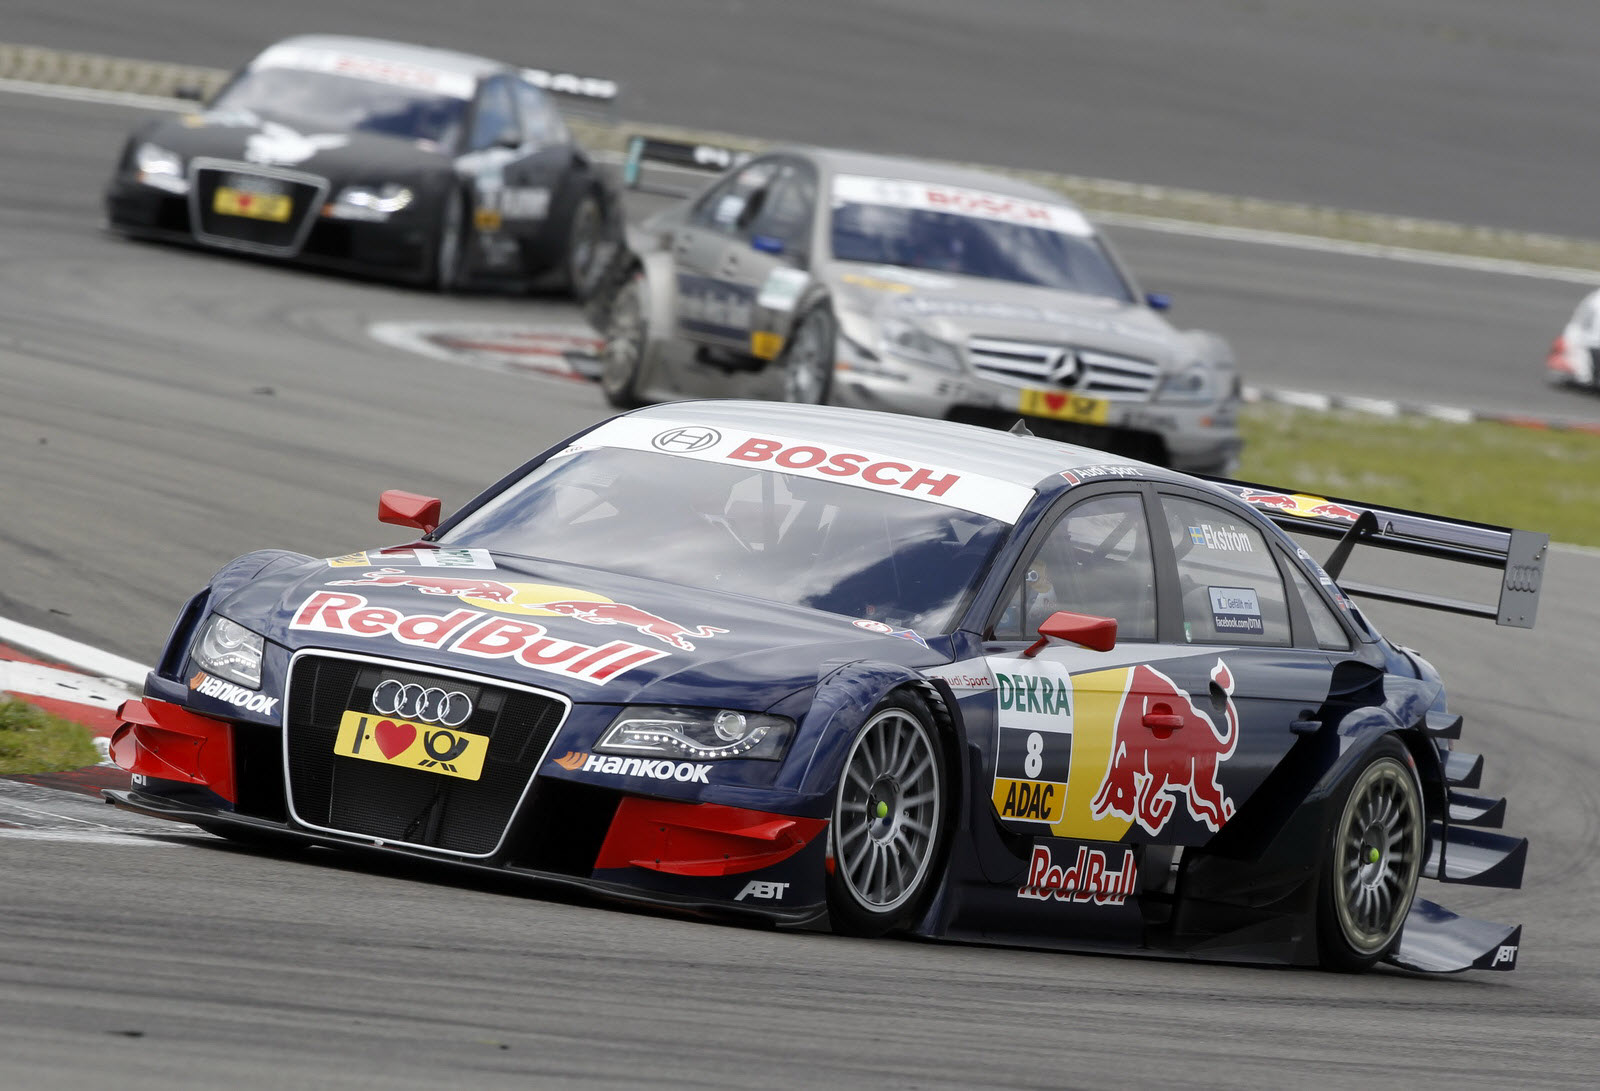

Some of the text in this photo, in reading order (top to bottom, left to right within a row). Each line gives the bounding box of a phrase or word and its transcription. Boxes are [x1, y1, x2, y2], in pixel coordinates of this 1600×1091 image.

[727, 438, 960, 497] BOSCH
[1201, 524, 1252, 552] Ekström
[289, 590, 672, 686] Red Bull
[1215, 616, 1262, 630] facebook.com/DTM
[962, 675, 990, 688] Sport
[996, 673, 1071, 717] DEKRA
[1024, 732, 1043, 778] 8
[1002, 781, 1054, 819] ADAC
[734, 880, 790, 901] ABT
[1017, 845, 1088, 902] Red
[1491, 945, 1518, 967] ABT
